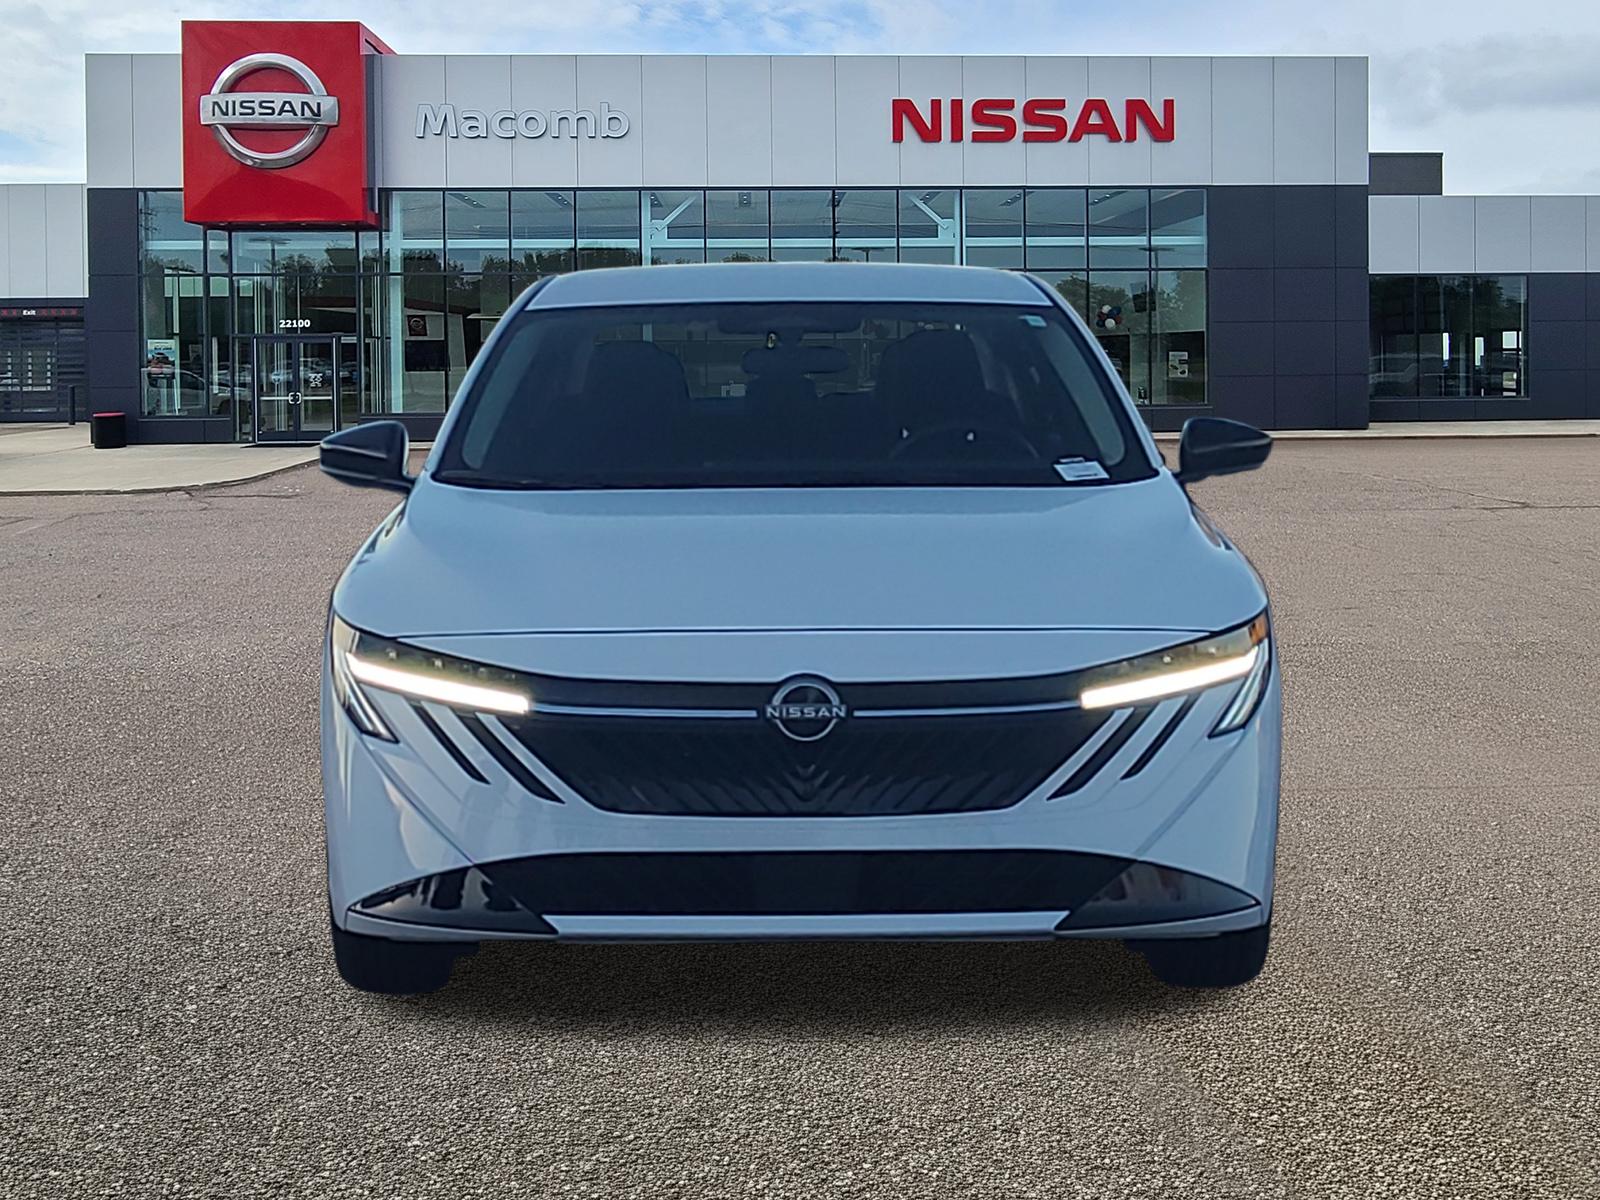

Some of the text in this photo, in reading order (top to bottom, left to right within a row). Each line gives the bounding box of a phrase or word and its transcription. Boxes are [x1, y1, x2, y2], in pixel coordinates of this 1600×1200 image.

[211, 98, 322, 119] NISSAN
[415, 102, 631, 139] Macomb
[891, 98, 1175, 143] NISSAN
[279, 319, 311, 328] 22100
[765, 705, 846, 718] NISSAN
